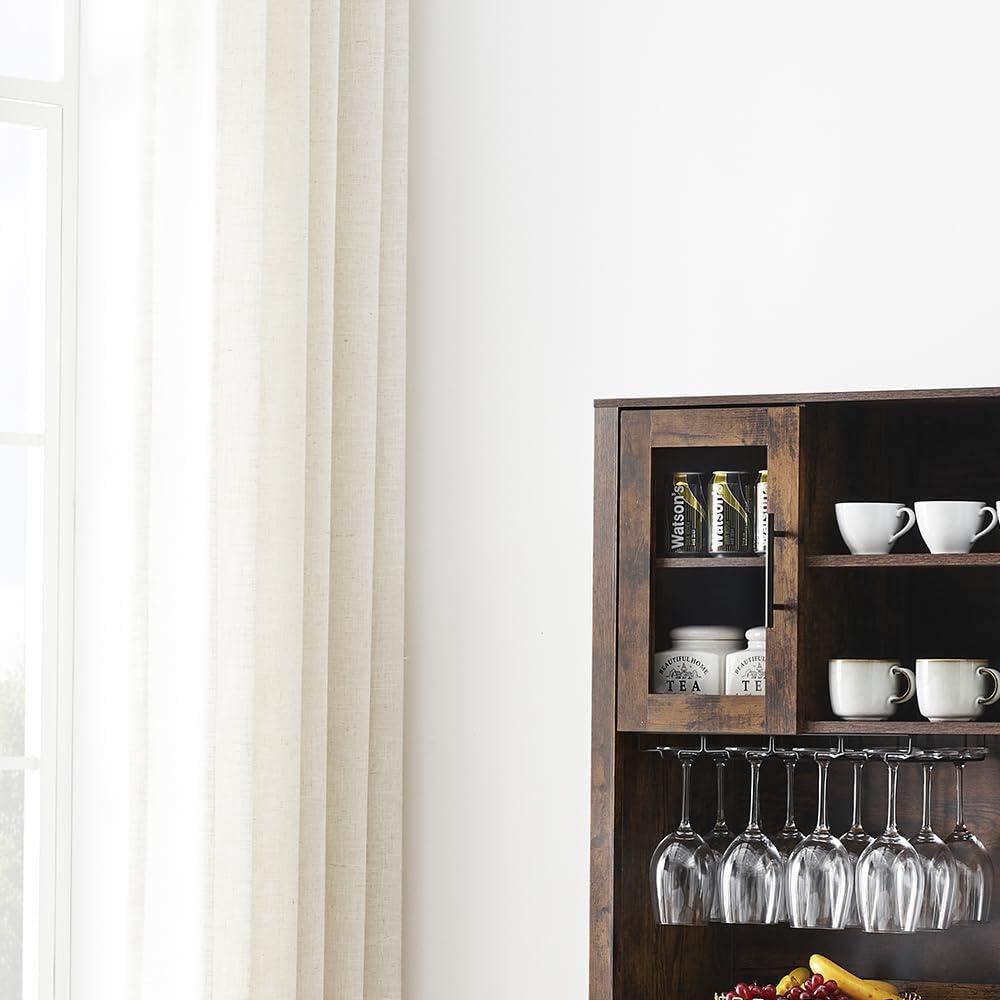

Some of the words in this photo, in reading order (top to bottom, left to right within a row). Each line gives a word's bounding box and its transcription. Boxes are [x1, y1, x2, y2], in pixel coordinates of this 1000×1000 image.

[671, 485, 685, 549] Watson's
[659, 656, 690, 675] BEAUTIFUL
[690, 658, 709, 674] HOME
[666, 680, 701, 692] TEA
[742, 680, 763, 692] TE
